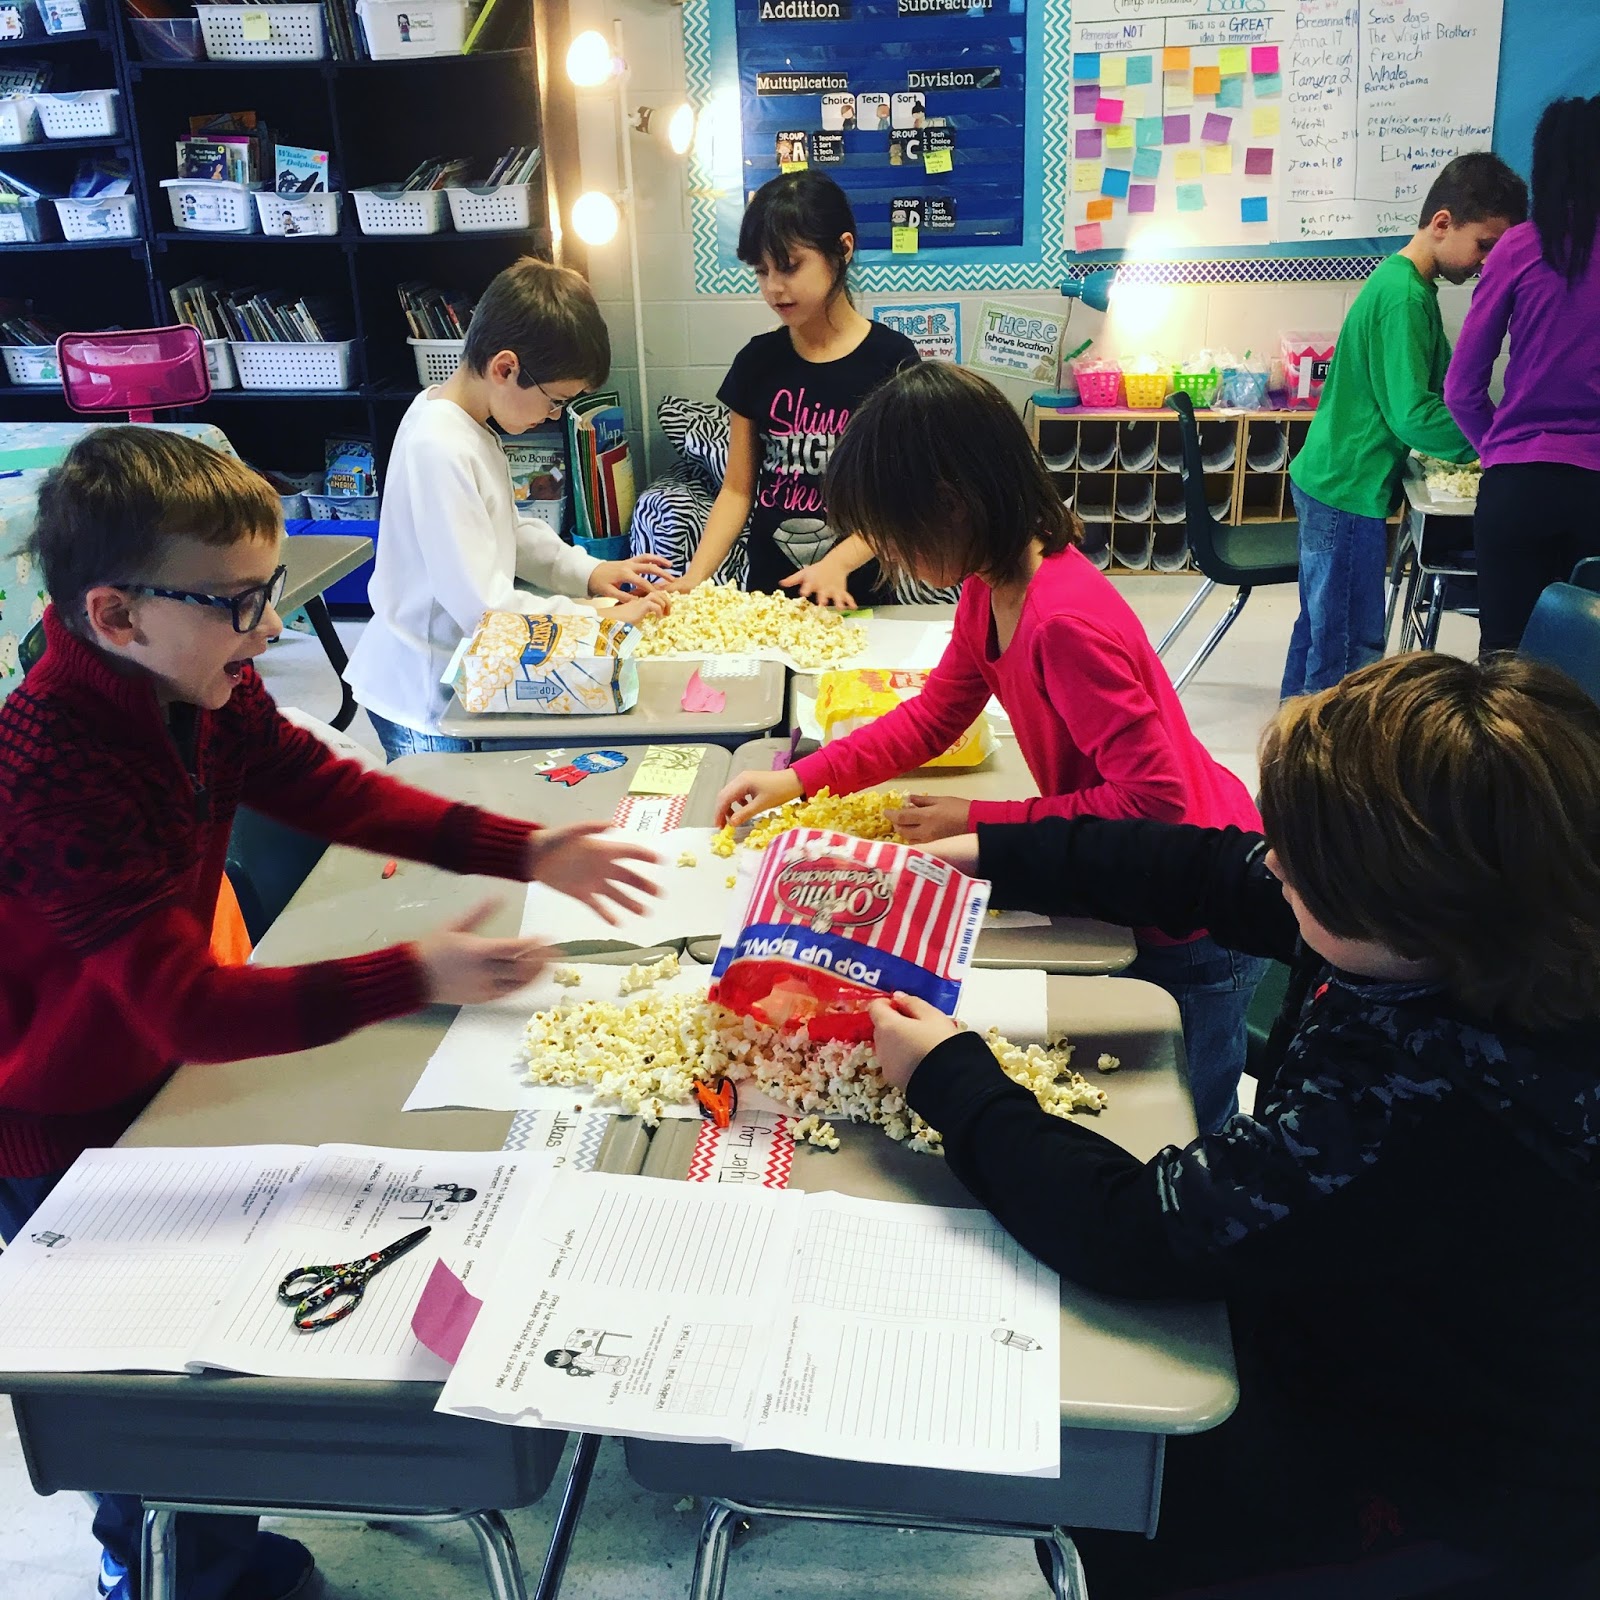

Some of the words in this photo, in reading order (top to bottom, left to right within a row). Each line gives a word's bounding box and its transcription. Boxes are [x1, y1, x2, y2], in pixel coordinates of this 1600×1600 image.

[761, 1, 841, 19] Addition
[1186, 18, 1203, 30] This
[1208, 19, 1216, 30] is
[1219, 21, 1226, 29] a
[1229, 16, 1274, 31] GREAT
[1403, 8, 1430, 29] dogs
[1080, 28, 1120, 40] Remember
[1123, 24, 1146, 39] NOT
[1200, 32, 1216, 43] idea
[1219, 32, 1226, 42] to
[1228, 30, 1269, 43] remember!
[1289, 32, 1328, 50] Anna
[1332, 29, 1343, 46] 17
[1368, 28, 1386, 45] The
[1437, 22, 1478, 40] Brothers
[1094, 41, 1103, 50] to
[1104, 40, 1115, 50] do
[1115, 39, 1133, 49] this
[908, 72, 975, 88] Division
[1340, 66, 1353, 84] 2
[1368, 64, 1408, 83] Whales
[757, 76, 848, 91] Multiplication
[1364, 82, 1395, 93] Barack
[822, 96, 855, 105] Choice
[862, 94, 884, 104] Tech
[897, 94, 918, 103] Sort
[779, 132, 805, 141] GROUP
[891, 130, 918, 139] GROUP
[278, 149, 308, 160] Whales
[793, 142, 806, 162] A
[906, 140, 920, 160] C
[1381, 145, 1459, 163] Endangered
[286, 158, 322, 169] Dolphins
[1332, 157, 1343, 169] 18
[893, 200, 919, 208] GROUP
[908, 210, 920, 228] D
[918, 348, 937, 358] their
[990, 356, 1007, 364] over
[998, 346, 1025, 356] glasses
[1026, 352, 1040, 360] are
[768, 388, 850, 436] Shine
[330, 481, 358, 489] AMERICA
[760, 467, 823, 512] Like
[539, 686, 556, 695] TOP
[788, 884, 874, 917] Orville
[970, 897, 982, 916] OPEN
[967, 916, 976, 926] TO
[962, 928, 974, 945] HERE
[743, 935, 799, 958] BOWL
[803, 947, 834, 968] UP
[957, 946, 969, 965] HOLD
[834, 955, 882, 987] POP
[727, 1125, 772, 1148] Lay
[718, 1153, 761, 1184] Tyler
[547, 1294, 561, 1312] faces!
[543, 1311, 557, 1321] any
[536, 1322, 549, 1338] show
[680, 1330, 691, 1341] Trial
[495, 1374, 508, 1389] Make
[503, 1360, 514, 1374] sure
[512, 1341, 524, 1353] take
[520, 1319, 535, 1342] pictures
[530, 1301, 547, 1319] during
[539, 1289, 550, 1302] your
[530, 1338, 541, 1350] NOT
[673, 1349, 684, 1360] Trial
[665, 1368, 676, 1380] Trial
[656, 1383, 672, 1410] Variables
[761, 1392, 773, 1419] Conclusion
